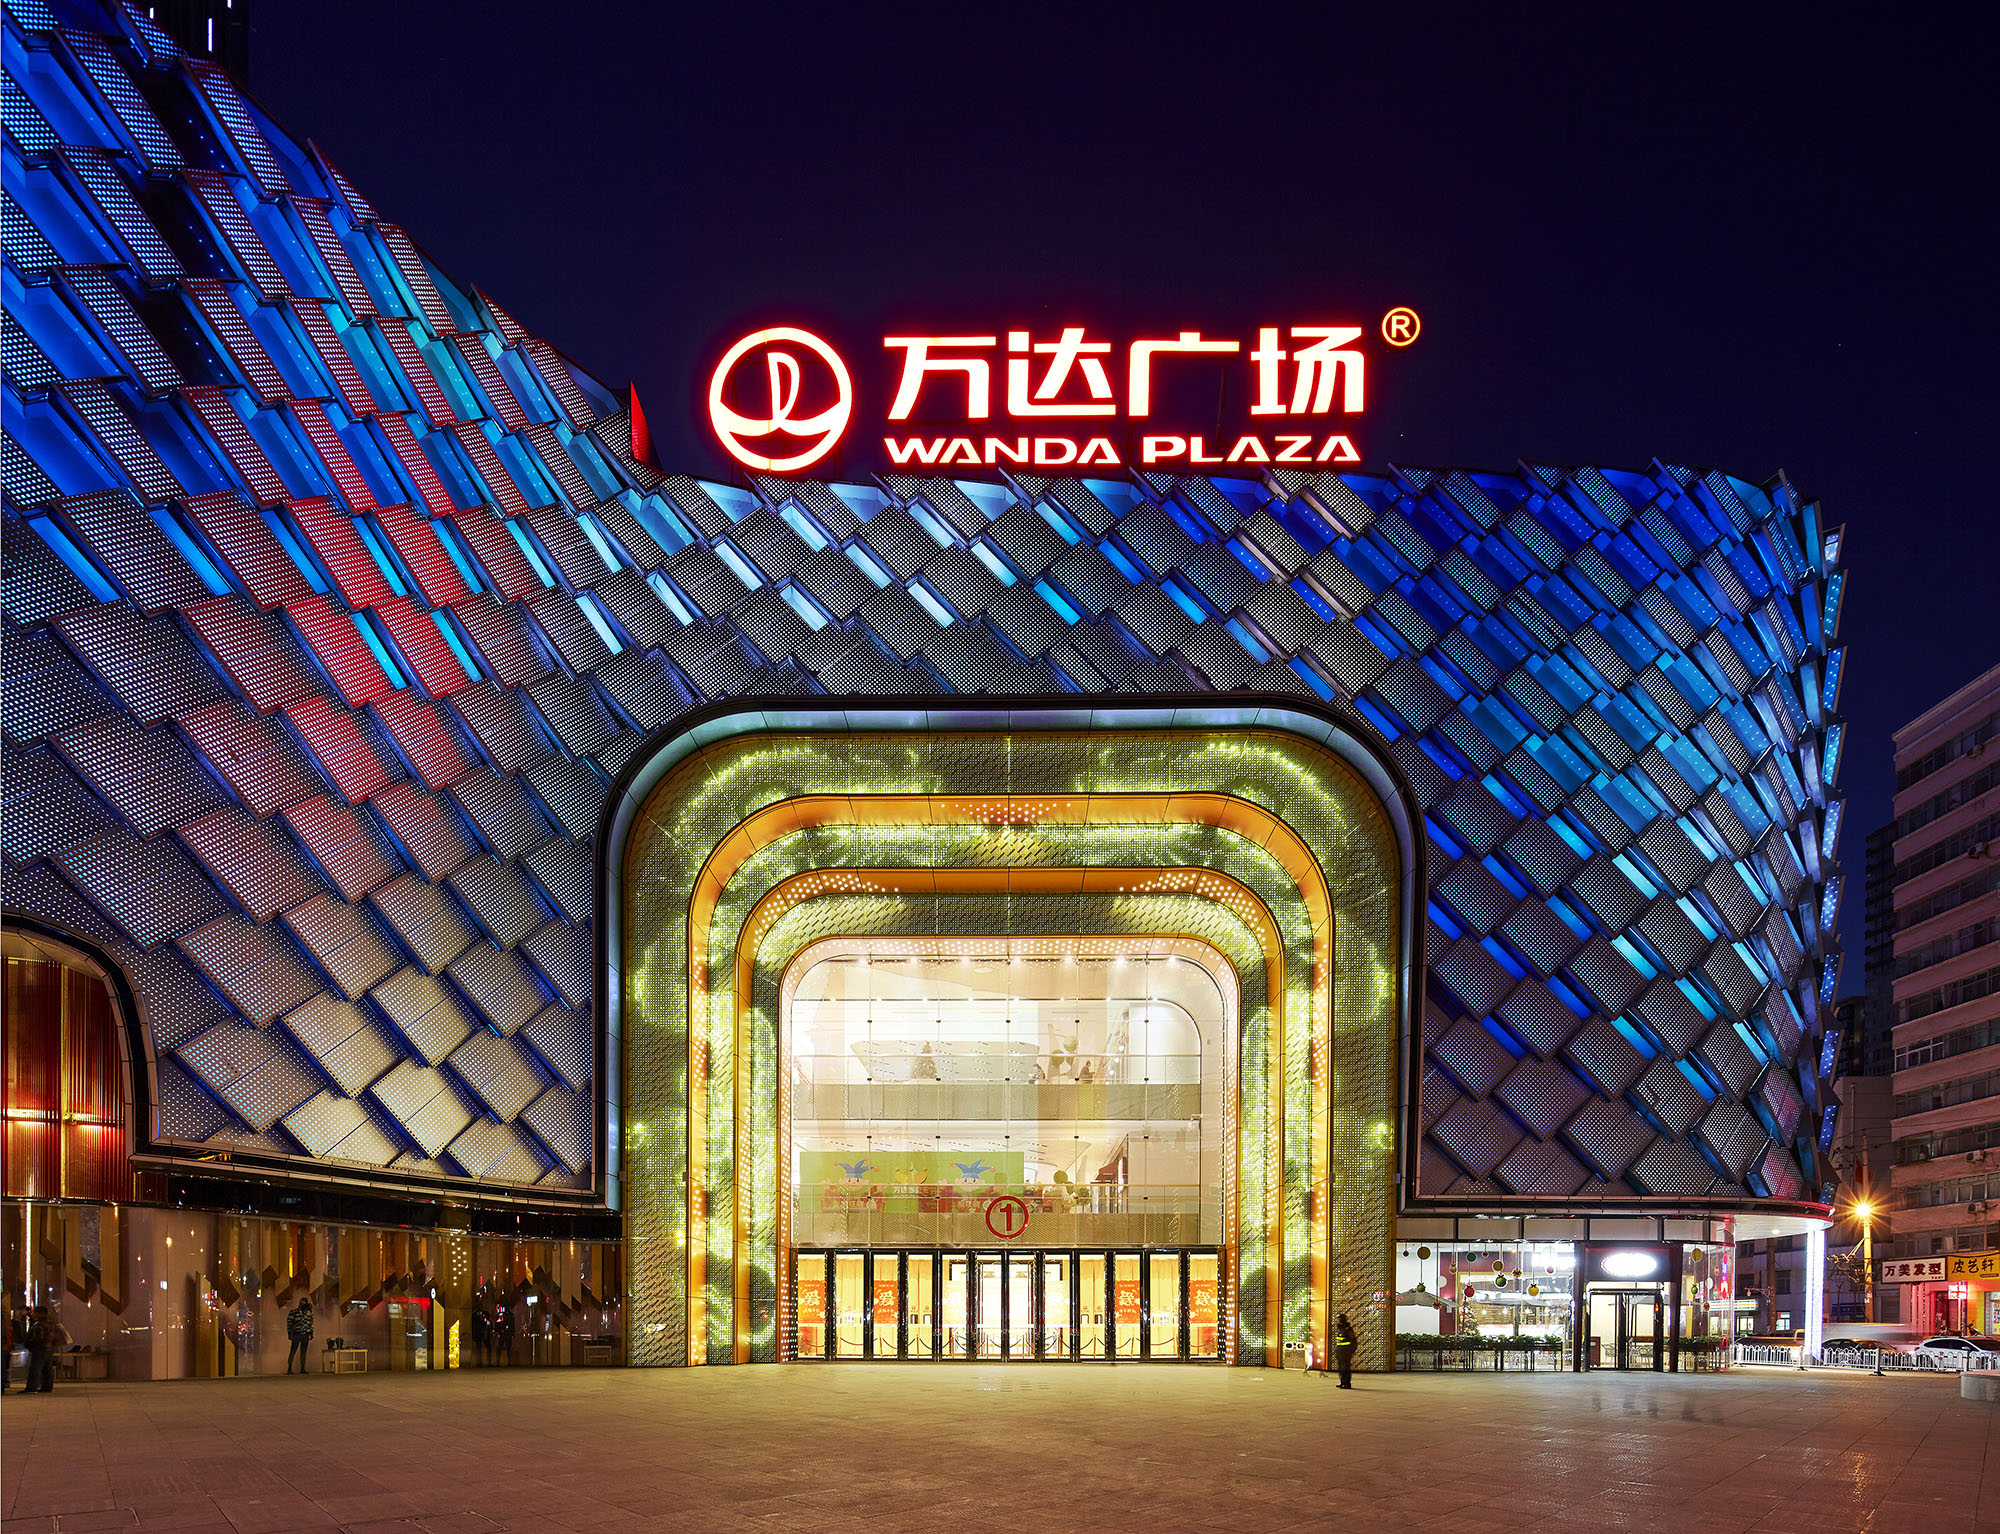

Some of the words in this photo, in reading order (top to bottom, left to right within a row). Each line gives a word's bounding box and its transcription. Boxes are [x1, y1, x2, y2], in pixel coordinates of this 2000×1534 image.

[883, 327, 1364, 420] 万达广场
[883, 437, 1121, 464] WANDA
[1142, 435, 1361, 463] PLAZA
[1885, 1263, 1941, 1277] 万美发型
[1952, 1259, 1994, 1273] 皮艺轩
